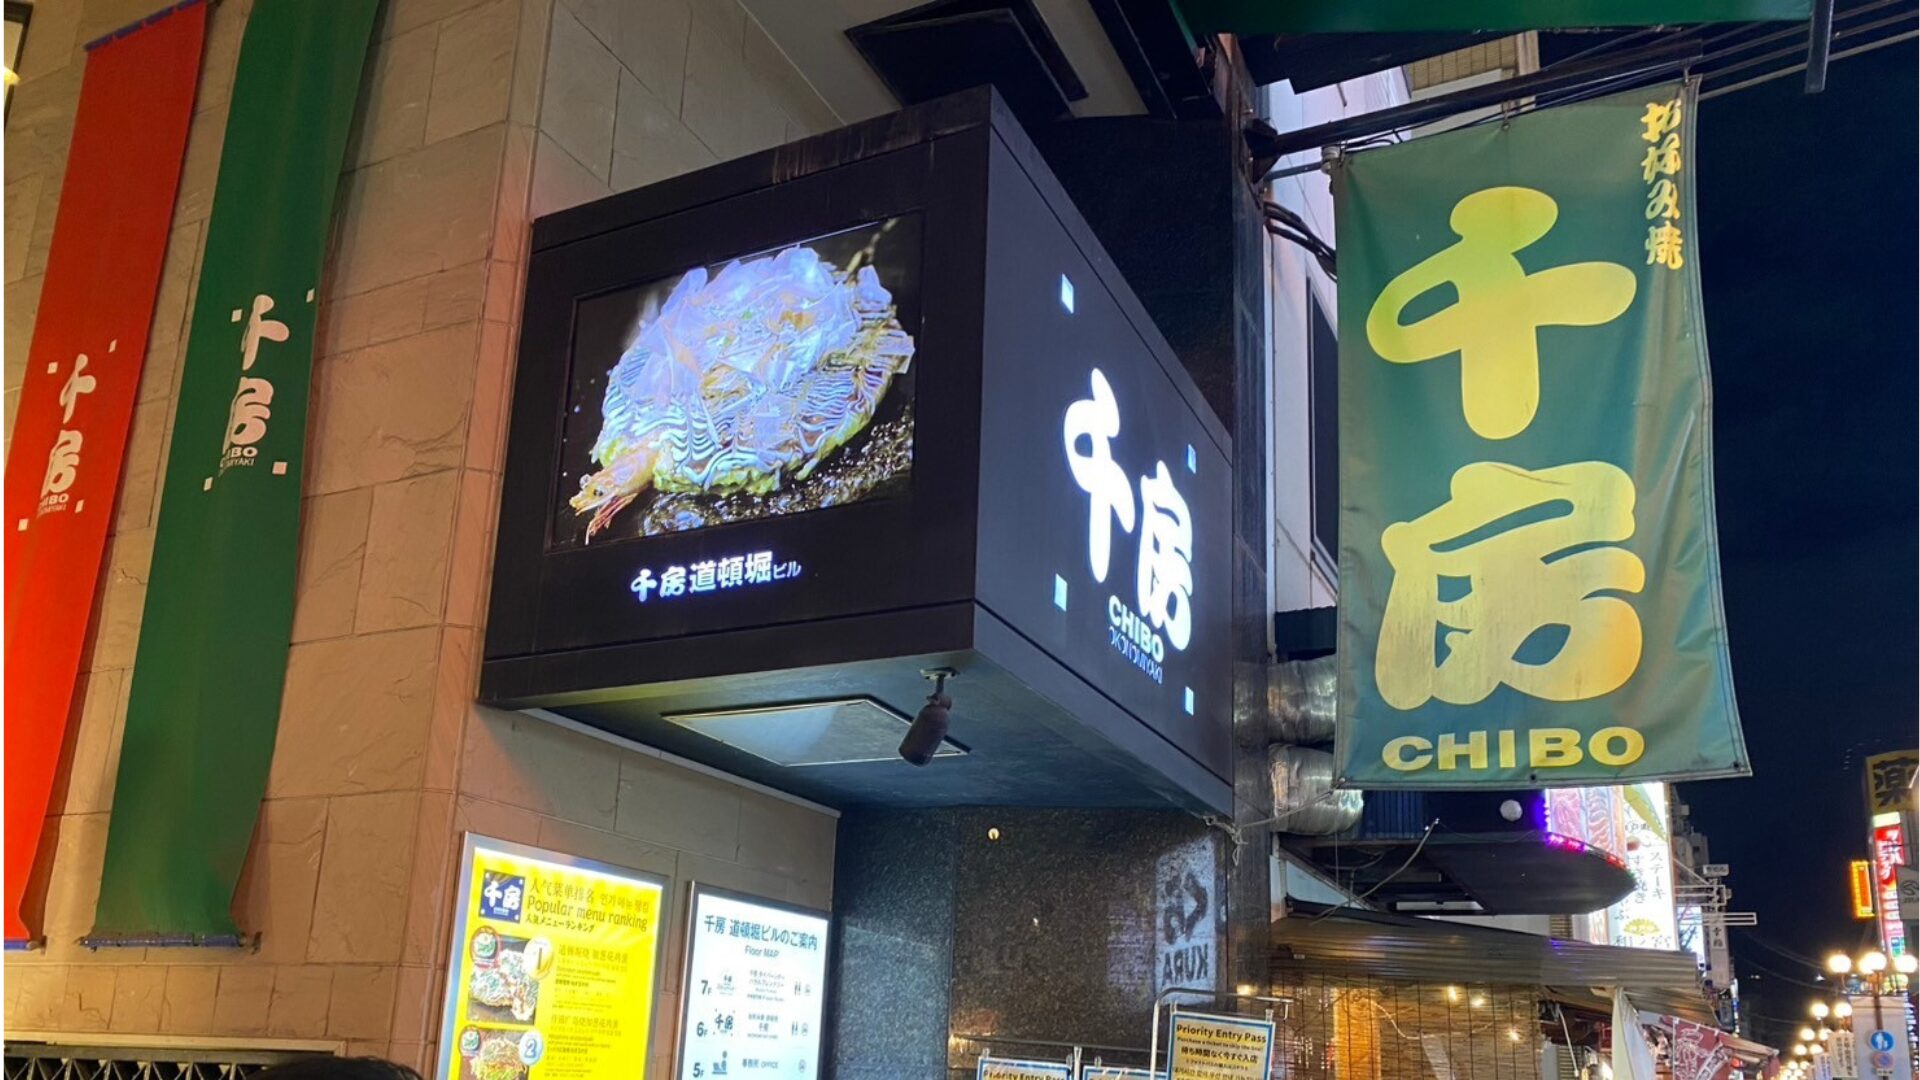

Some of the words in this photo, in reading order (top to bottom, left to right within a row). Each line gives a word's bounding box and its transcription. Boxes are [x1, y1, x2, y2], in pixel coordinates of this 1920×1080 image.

[1366, 186, 1646, 710] 千房
[1063, 367, 1193, 651] 千房
[1109, 595, 1164, 663] CHIBO
[1381, 726, 1645, 772] CHIBO
[527, 894, 573, 916] Popular
[576, 907, 606, 922] menu
[608, 911, 648, 932] ranking
[704, 914, 727, 935] 千房
[729, 919, 818, 951] 道頓堀ビルのご案内
[744, 944, 762, 956] Floor
[763, 948, 780, 958] MAP
[525, 1038, 539, 1059] 2
[1176, 1023, 1214, 1038] Priority
[1215, 1029, 1242, 1042] Entry
[1244, 1032, 1267, 1044] Pass
